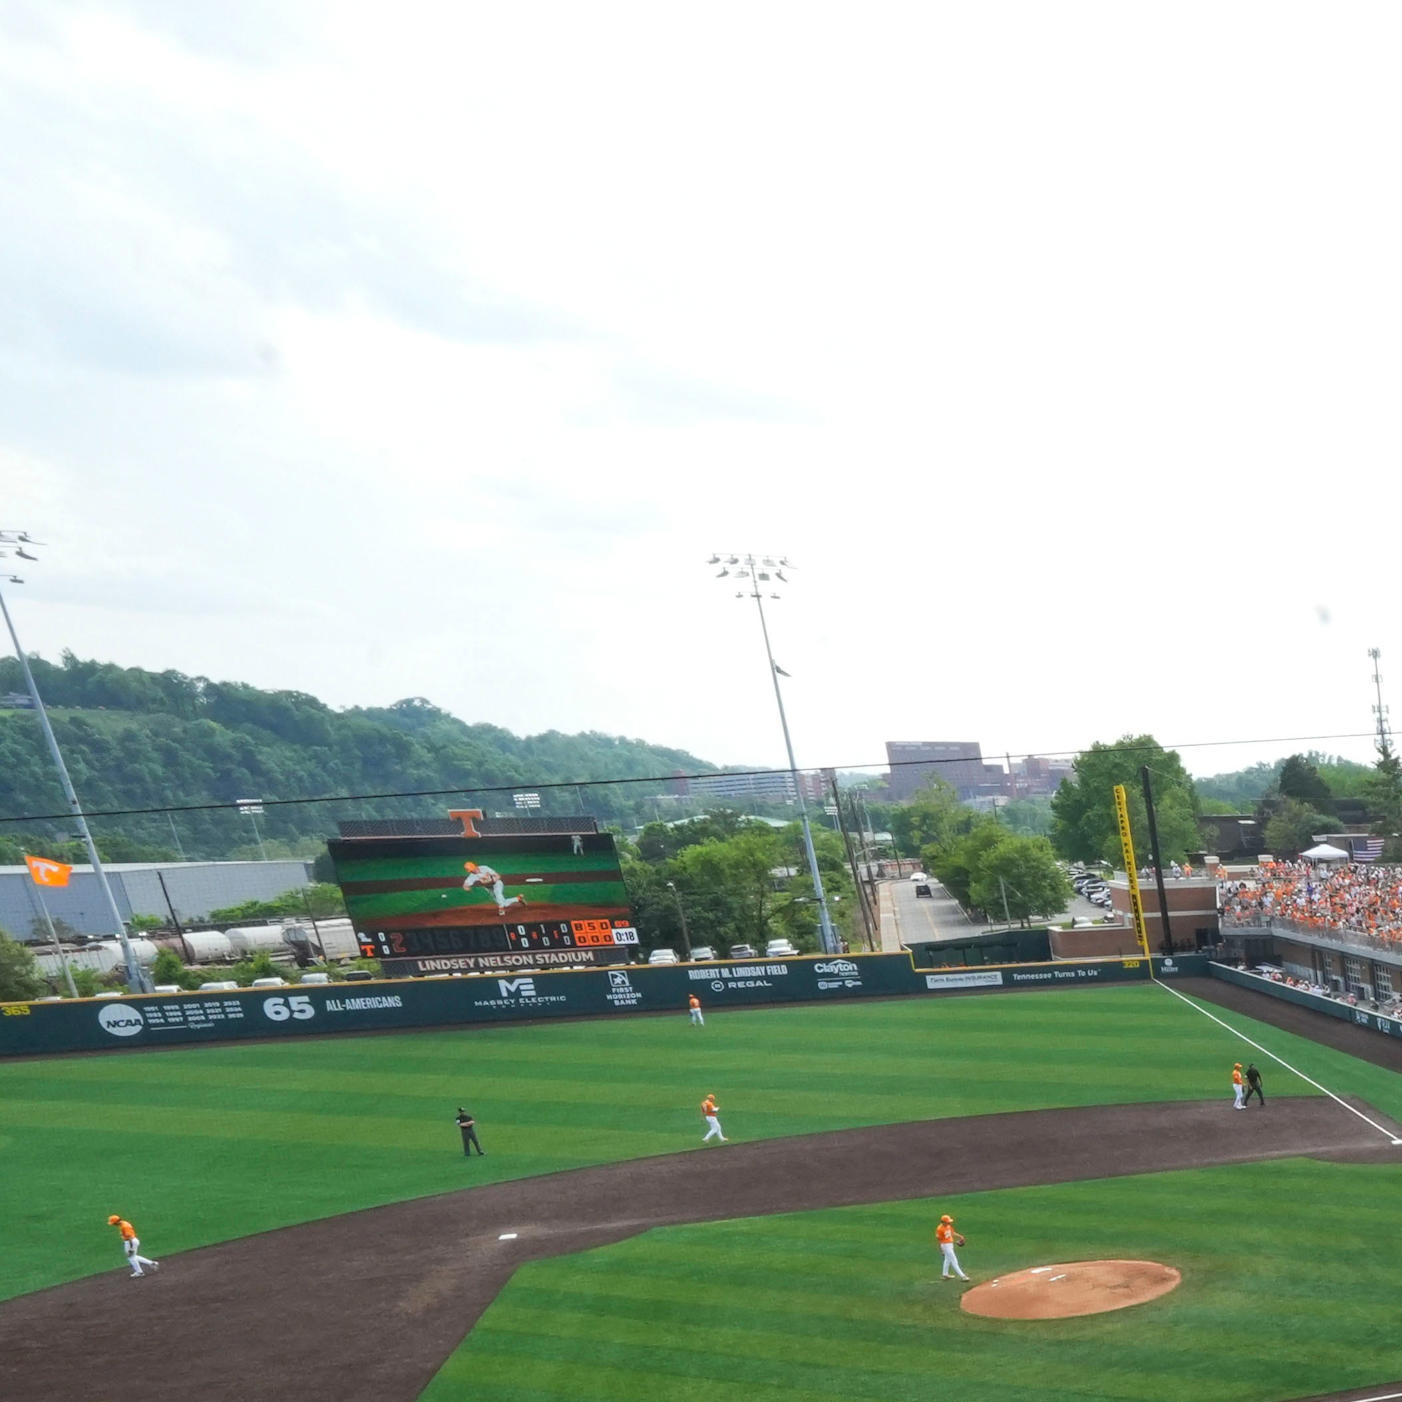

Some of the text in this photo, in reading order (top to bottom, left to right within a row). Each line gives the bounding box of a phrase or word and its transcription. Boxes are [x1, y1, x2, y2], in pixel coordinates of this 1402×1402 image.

[447, 808, 484, 838] T
[616, 931, 635, 942] 0:18
[418, 951, 594, 971] LINDSEY NELSON STADIUM
[1123, 960, 1140, 968] 320
[688, 964, 788, 980] ROBERT M. LINDSAY FIELD
[814, 961, 858, 975] Clayton
[1013, 969, 1098, 980] Tennessee Turns To Us
[728, 980, 773, 989] REGAL
[474, 998, 515, 1007] MASSEY
[519, 995, 567, 1004] ELECTRIC
[606, 992, 642, 1000] HORIZON
[263, 995, 315, 1021] 65
[325, 995, 402, 1012] ALL-AMERICANS
[2, 1005, 30, 1017] 365
[106, 1019, 144, 1029] NCAA
